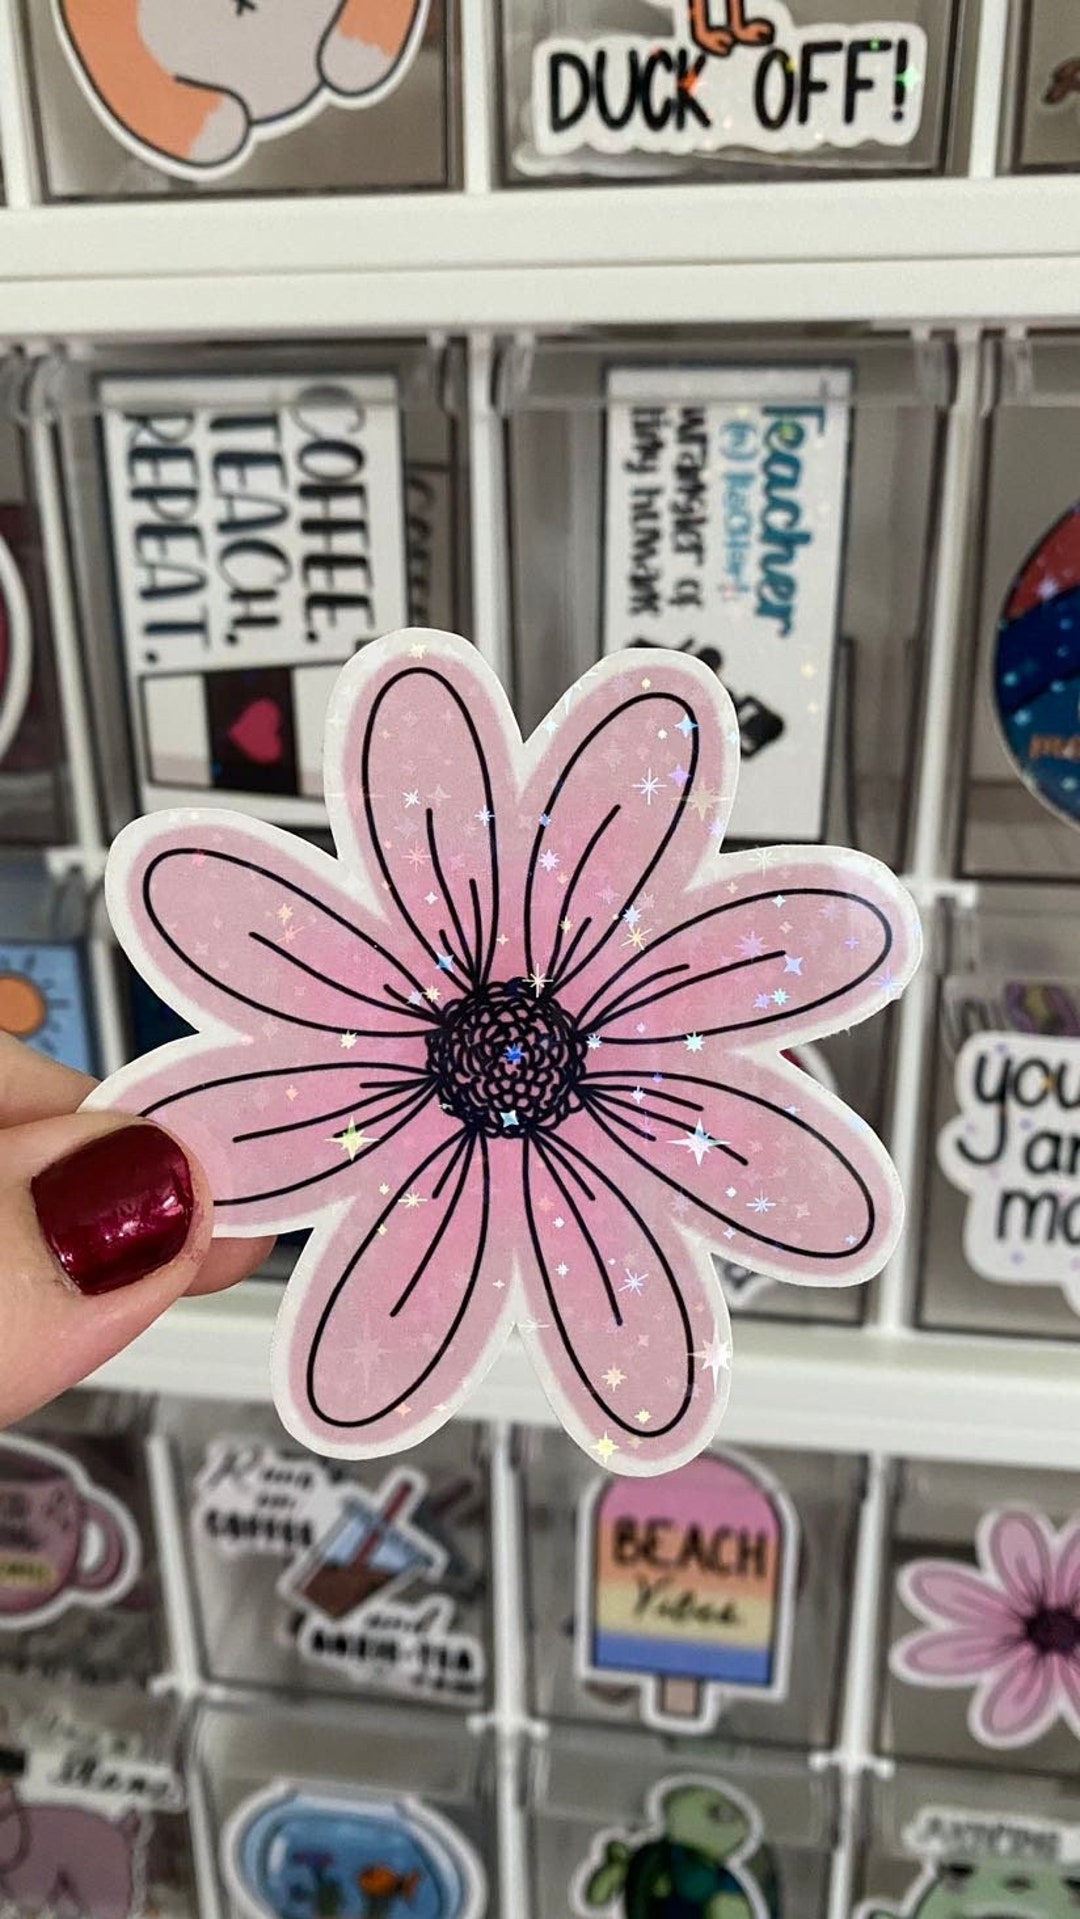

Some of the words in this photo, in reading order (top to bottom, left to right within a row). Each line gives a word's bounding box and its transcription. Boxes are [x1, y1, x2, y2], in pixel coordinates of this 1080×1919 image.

[548, 47, 711, 133] DUCK
[754, 38, 909, 130] OFF!
[124, 409, 213, 665] REPEAT.
[207, 412, 294, 646] TEACH.
[290, 385, 376, 644] COFFEE.
[756, 385, 827, 638] Teacher
[612, 1515, 768, 1580] BEACH
